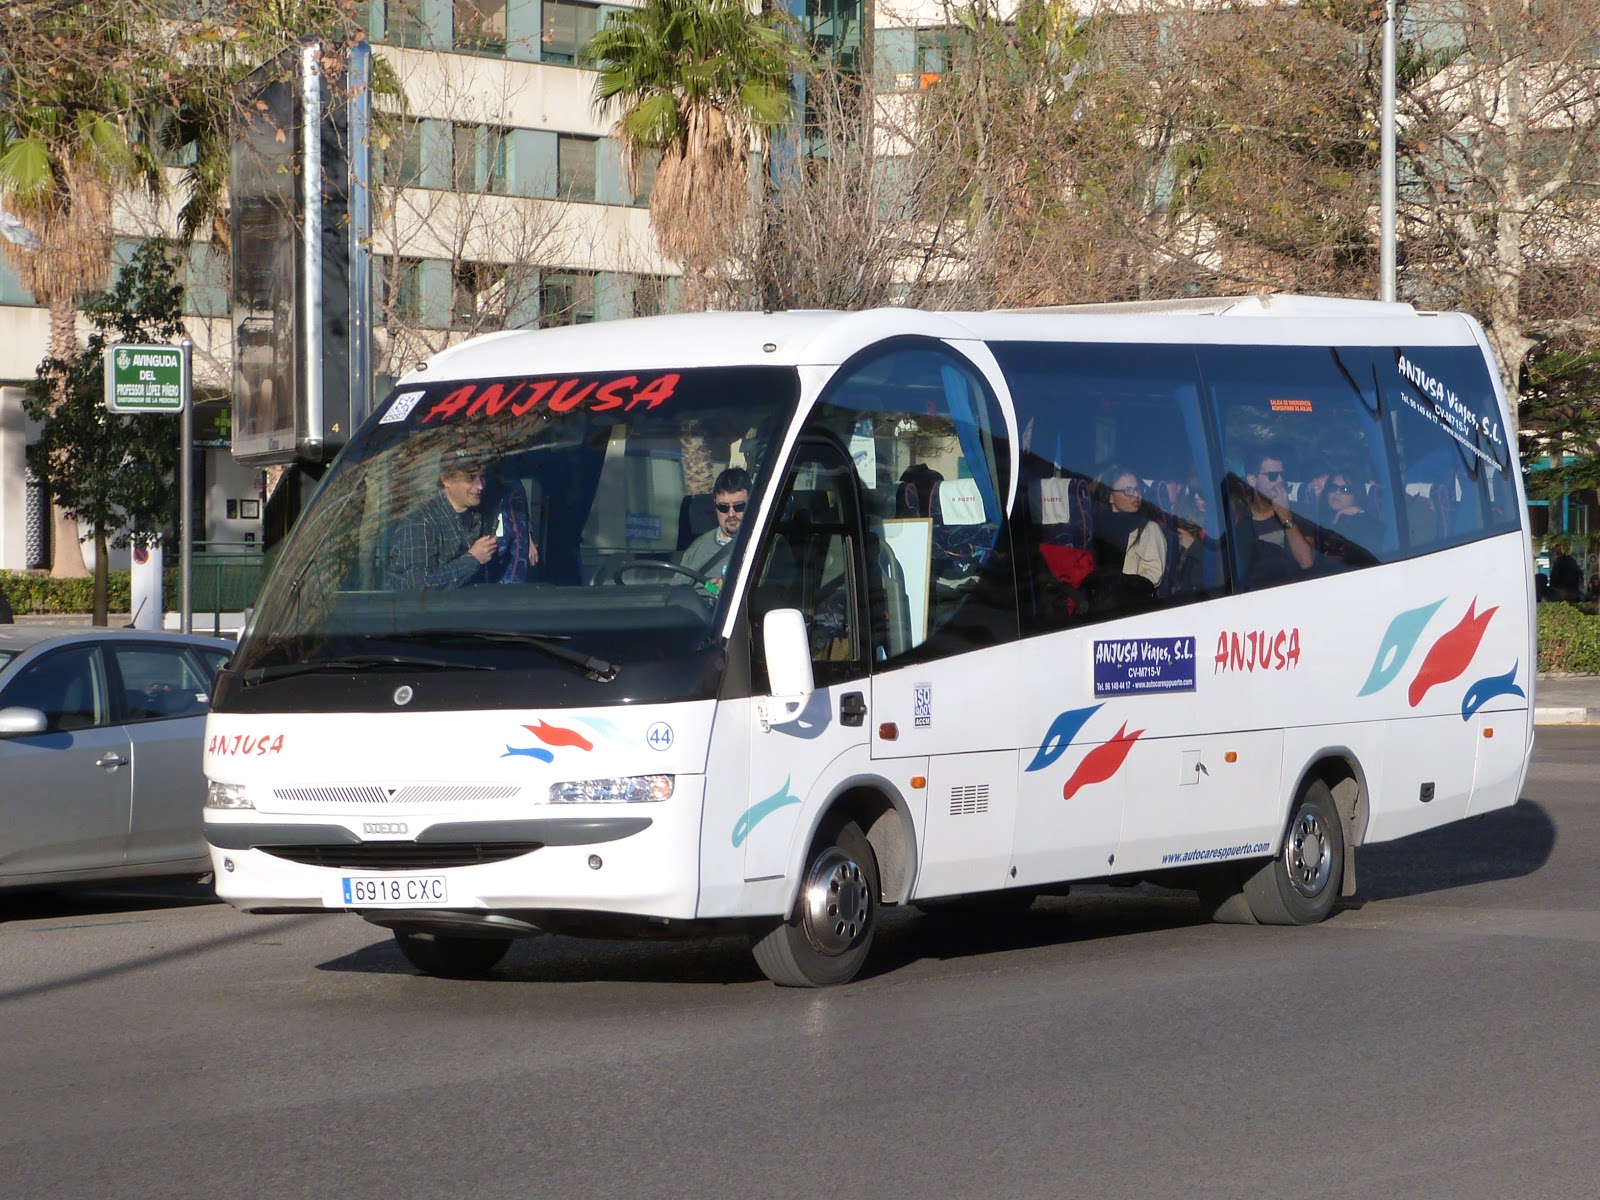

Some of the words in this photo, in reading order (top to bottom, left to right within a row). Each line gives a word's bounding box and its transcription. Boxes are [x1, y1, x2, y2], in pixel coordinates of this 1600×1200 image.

[132, 354, 178, 367] AVINGUDA
[139, 370, 156, 380] DEL
[116, 383, 145, 396] PROFESSOR
[145, 381, 160, 396] LÓPEZ
[161, 382, 179, 397] PIÑERO
[421, 373, 681, 424] ANJUSA
[1398, 355, 1445, 402] ANJUSA
[1482, 416, 1502, 445] S.L.
[331, 422, 340, 433] 4
[1434, 404, 1470, 436] CV-M715-V
[1096, 641, 1138, 664] ANJUSA
[1174, 639, 1193, 660] S.L.
[1214, 627, 1301, 675] ANJUSA
[1128, 666, 1161, 678] CV-M715-V
[1096, 682, 1105, 691] Tel.
[1125, 681, 1131, 689] 17
[914, 688, 930, 707] ISO
[915, 704, 931, 715] 9001
[650, 729, 671, 744] 44
[208, 734, 284, 758] ANJUSA
[363, 822, 409, 834] IVECO
[1161, 842, 1270, 864] www.autocaresppuerto.com
[355, 881, 401, 900] 6918
[407, 880, 443, 900] CXC
